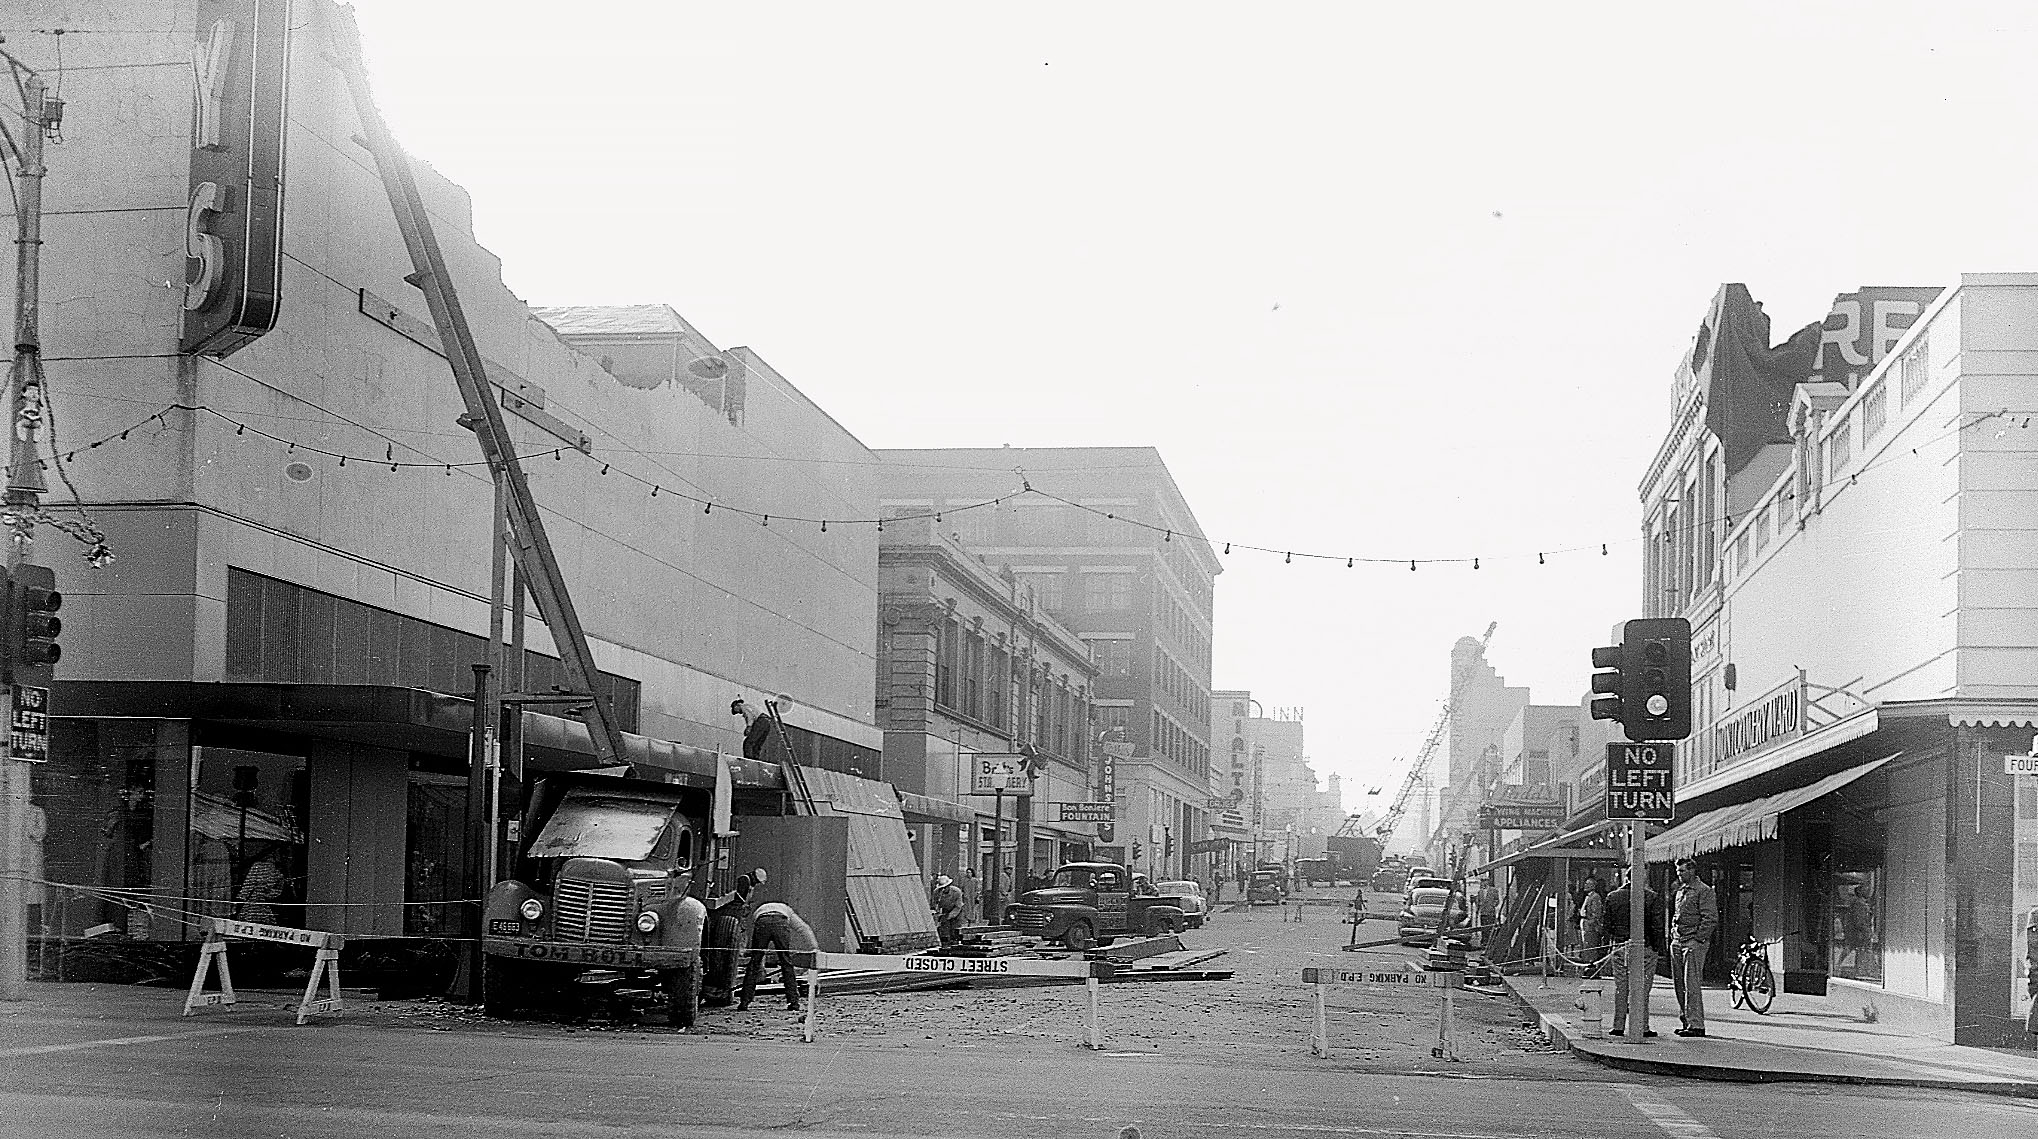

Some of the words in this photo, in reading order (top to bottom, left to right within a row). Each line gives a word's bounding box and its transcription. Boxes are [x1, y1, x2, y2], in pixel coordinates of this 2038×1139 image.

[20, 690, 41, 708] NO
[12, 708, 46, 730] LEFT
[1273, 706, 1304, 722] INN
[10, 731, 48, 752] TURN
[1624, 747, 1657, 765] NO
[1611, 769, 1670, 787] LEFT
[1609, 791, 1671, 809] TURN
[1062, 812, 1111, 821] FOUNTAIN
[1494, 818, 1558, 827] APPLIANCES
[259, 927, 295, 941] PARKING
[300, 933, 312, 943] NO
[513, 942, 569, 961] TOM
[959, 959, 1008, 973] STREET
[1369, 972, 1409, 984] PARKING
[1415, 974, 1427, 984] NO
